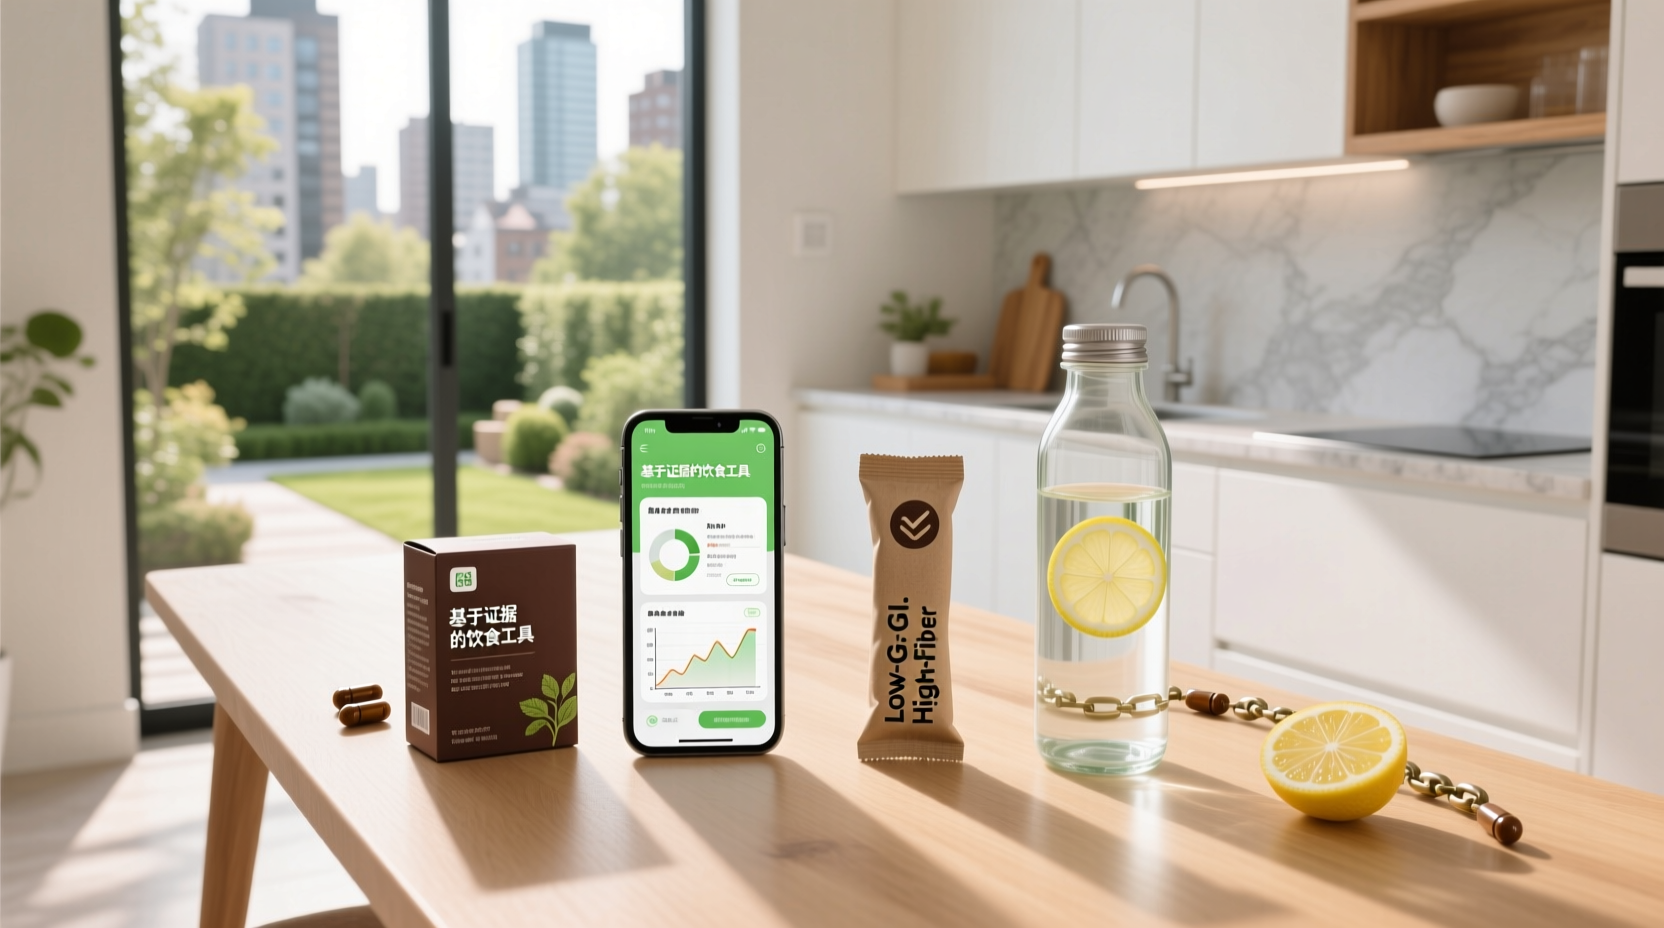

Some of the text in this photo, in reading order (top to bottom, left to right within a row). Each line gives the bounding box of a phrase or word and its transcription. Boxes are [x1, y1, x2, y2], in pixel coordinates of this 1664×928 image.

[449, 604, 517, 628] 基于证据
[450, 624, 535, 649] 的饮食工具
[912, 606, 940, 724] High-Fiber
